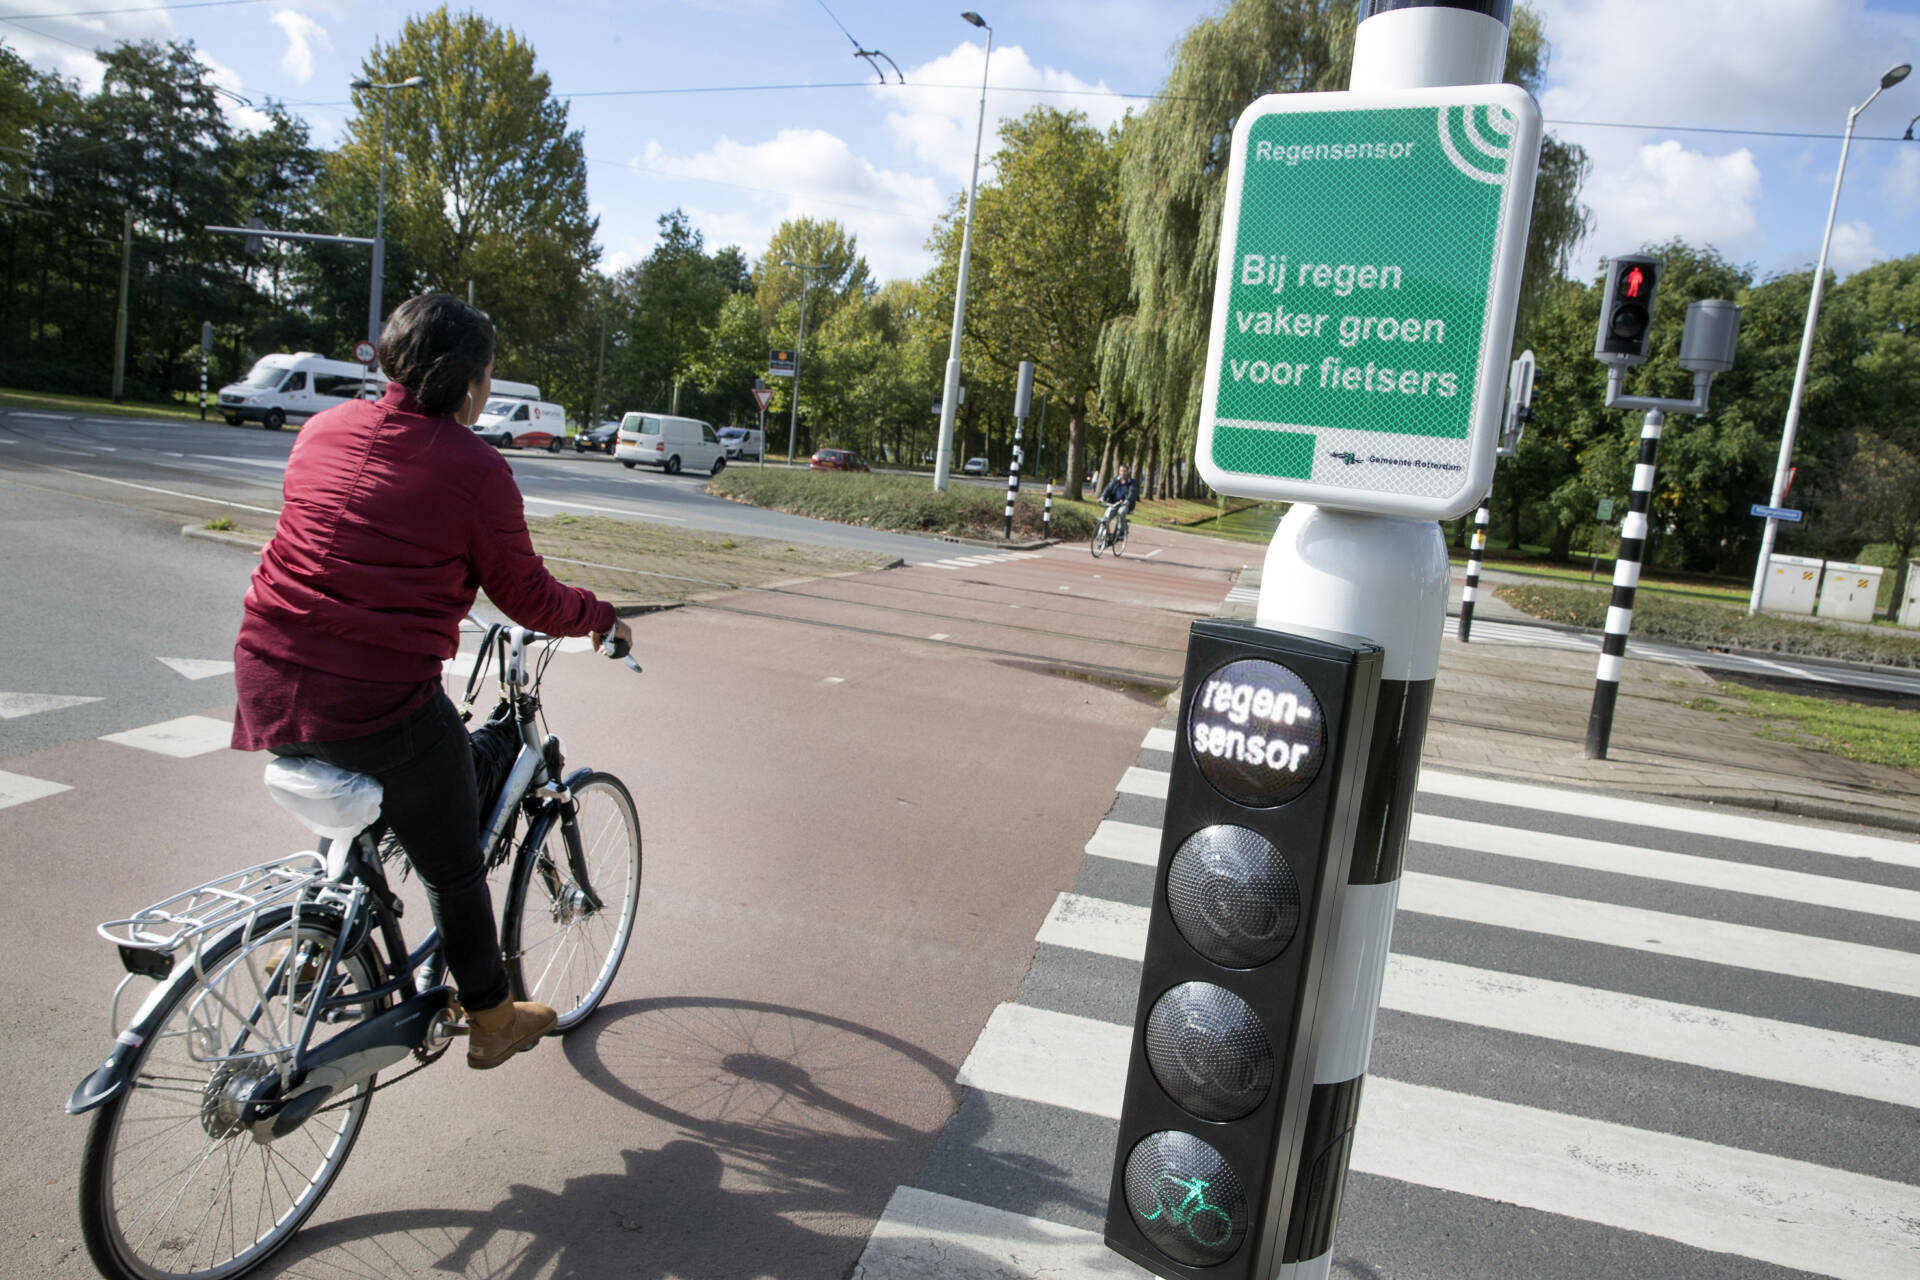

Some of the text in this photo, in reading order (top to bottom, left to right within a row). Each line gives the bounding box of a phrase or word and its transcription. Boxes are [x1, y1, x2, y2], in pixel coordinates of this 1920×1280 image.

[1256, 140, 1416, 166] Regensensor
[1241, 254, 1402, 297] Bij regen
[1236, 305, 1446, 347] vaker groen
[1229, 356, 1458, 397] voor fietsers
[1369, 455, 1462, 472] Gemeente Rotterdam
[1202, 680, 1312, 725] regen-
[1194, 722, 1310, 773] sensor
